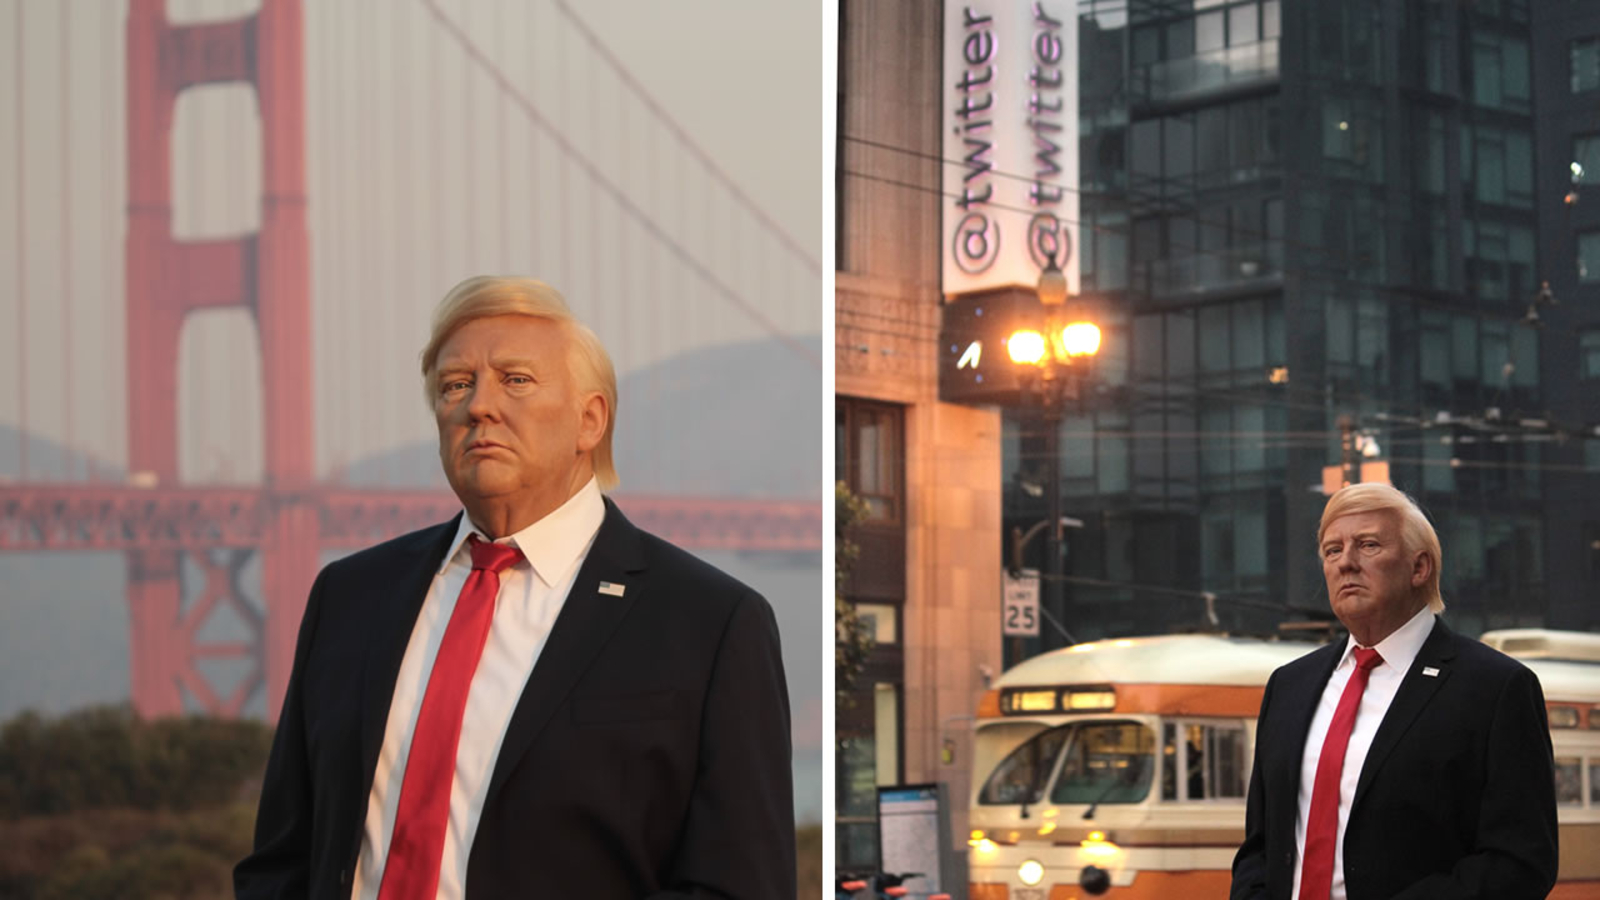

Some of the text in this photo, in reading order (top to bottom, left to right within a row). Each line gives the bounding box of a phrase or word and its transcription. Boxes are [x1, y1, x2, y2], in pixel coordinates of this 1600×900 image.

[953, 6, 1000, 275] @twitter
[1027, 2, 1072, 273] @twitter
[1008, 605, 1034, 629] 25
